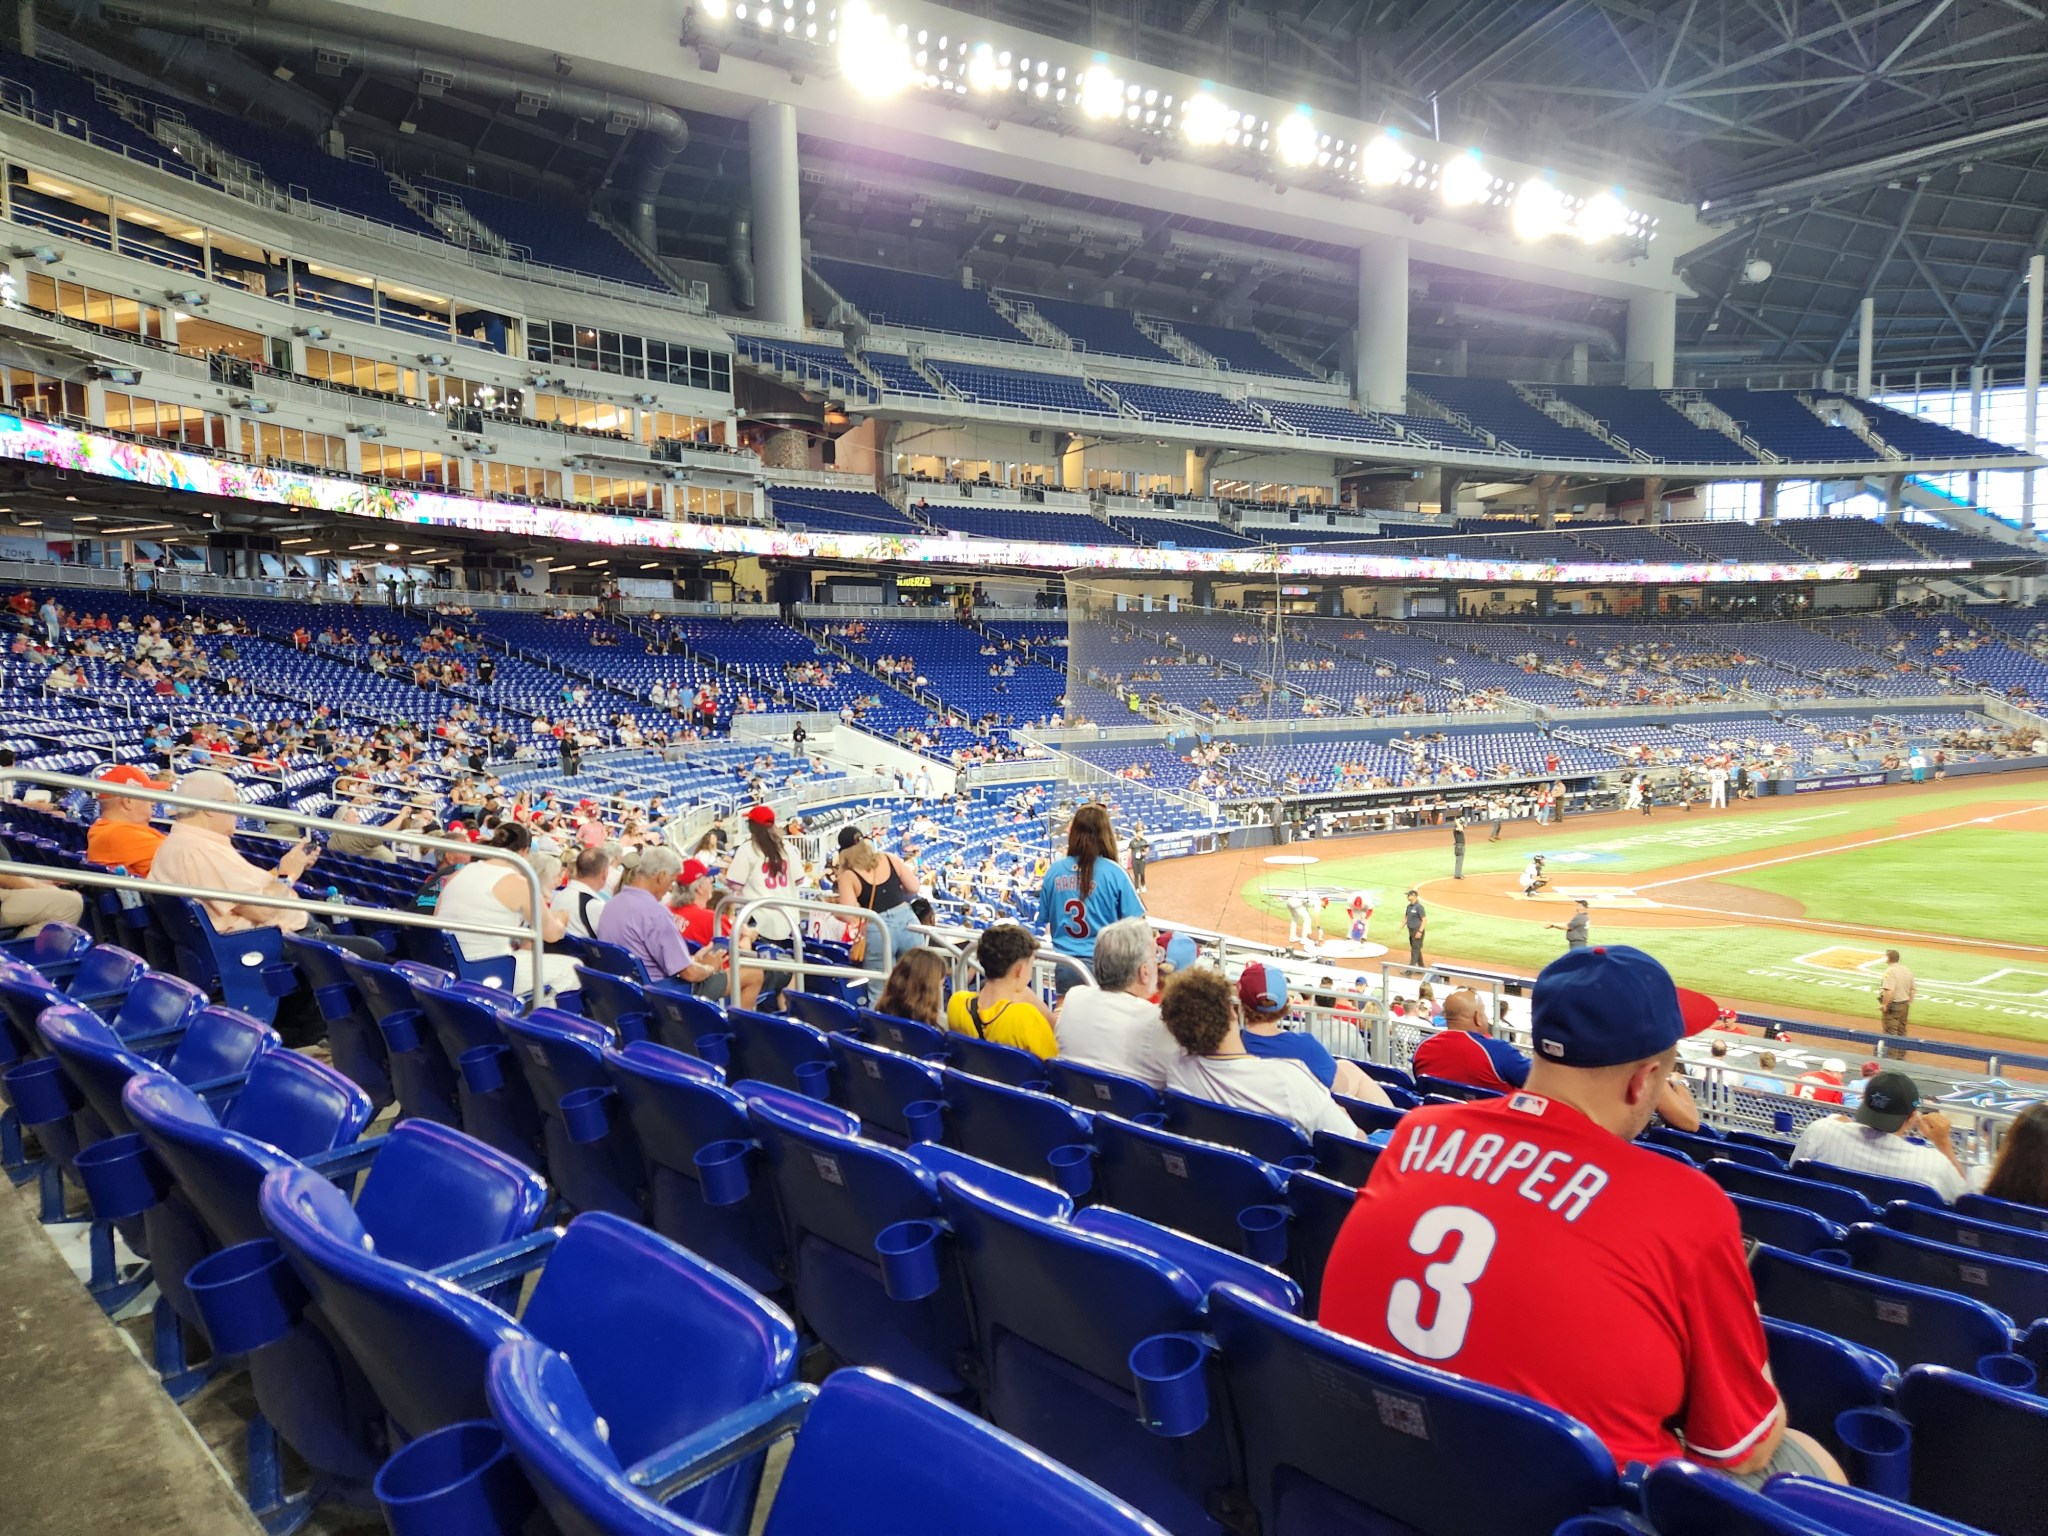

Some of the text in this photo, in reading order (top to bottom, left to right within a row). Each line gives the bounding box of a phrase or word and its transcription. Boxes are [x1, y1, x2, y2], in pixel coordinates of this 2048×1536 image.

[4, 548, 33, 559] ZONE
[1064, 898, 1090, 939] 3
[1746, 969, 1880, 994] OFFICIA
[1799, 1085, 1816, 1100] 6
[1400, 1125, 1609, 1222] HARPER
[1387, 1205, 1497, 1361] 3
